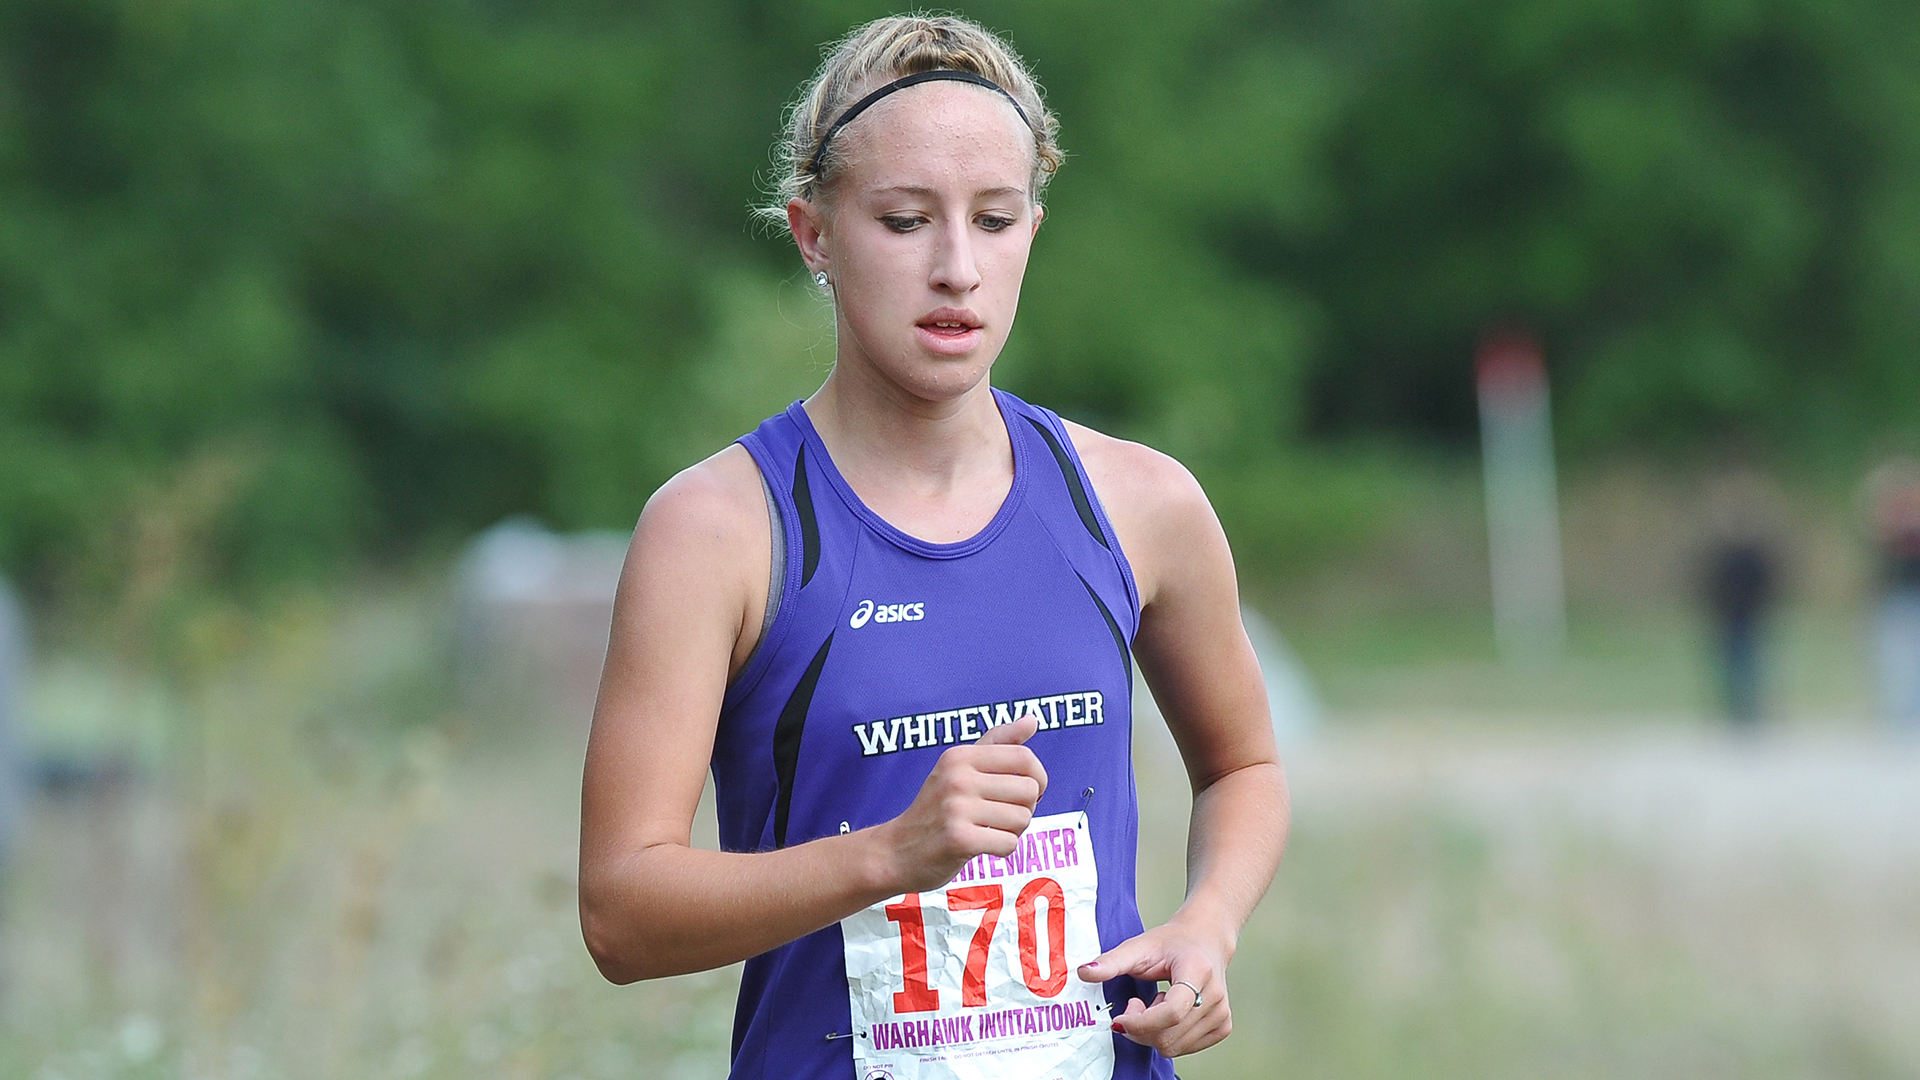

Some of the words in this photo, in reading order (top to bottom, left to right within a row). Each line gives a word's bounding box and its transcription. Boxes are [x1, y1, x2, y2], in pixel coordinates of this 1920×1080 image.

[874, 602, 925, 623] asics
[853, 690, 1105, 757] WHITEWATER
[885, 877, 1068, 1014] 170
[872, 1014, 974, 1051] WARHAWK
[979, 1000, 1097, 1040] INVITATIONAL
